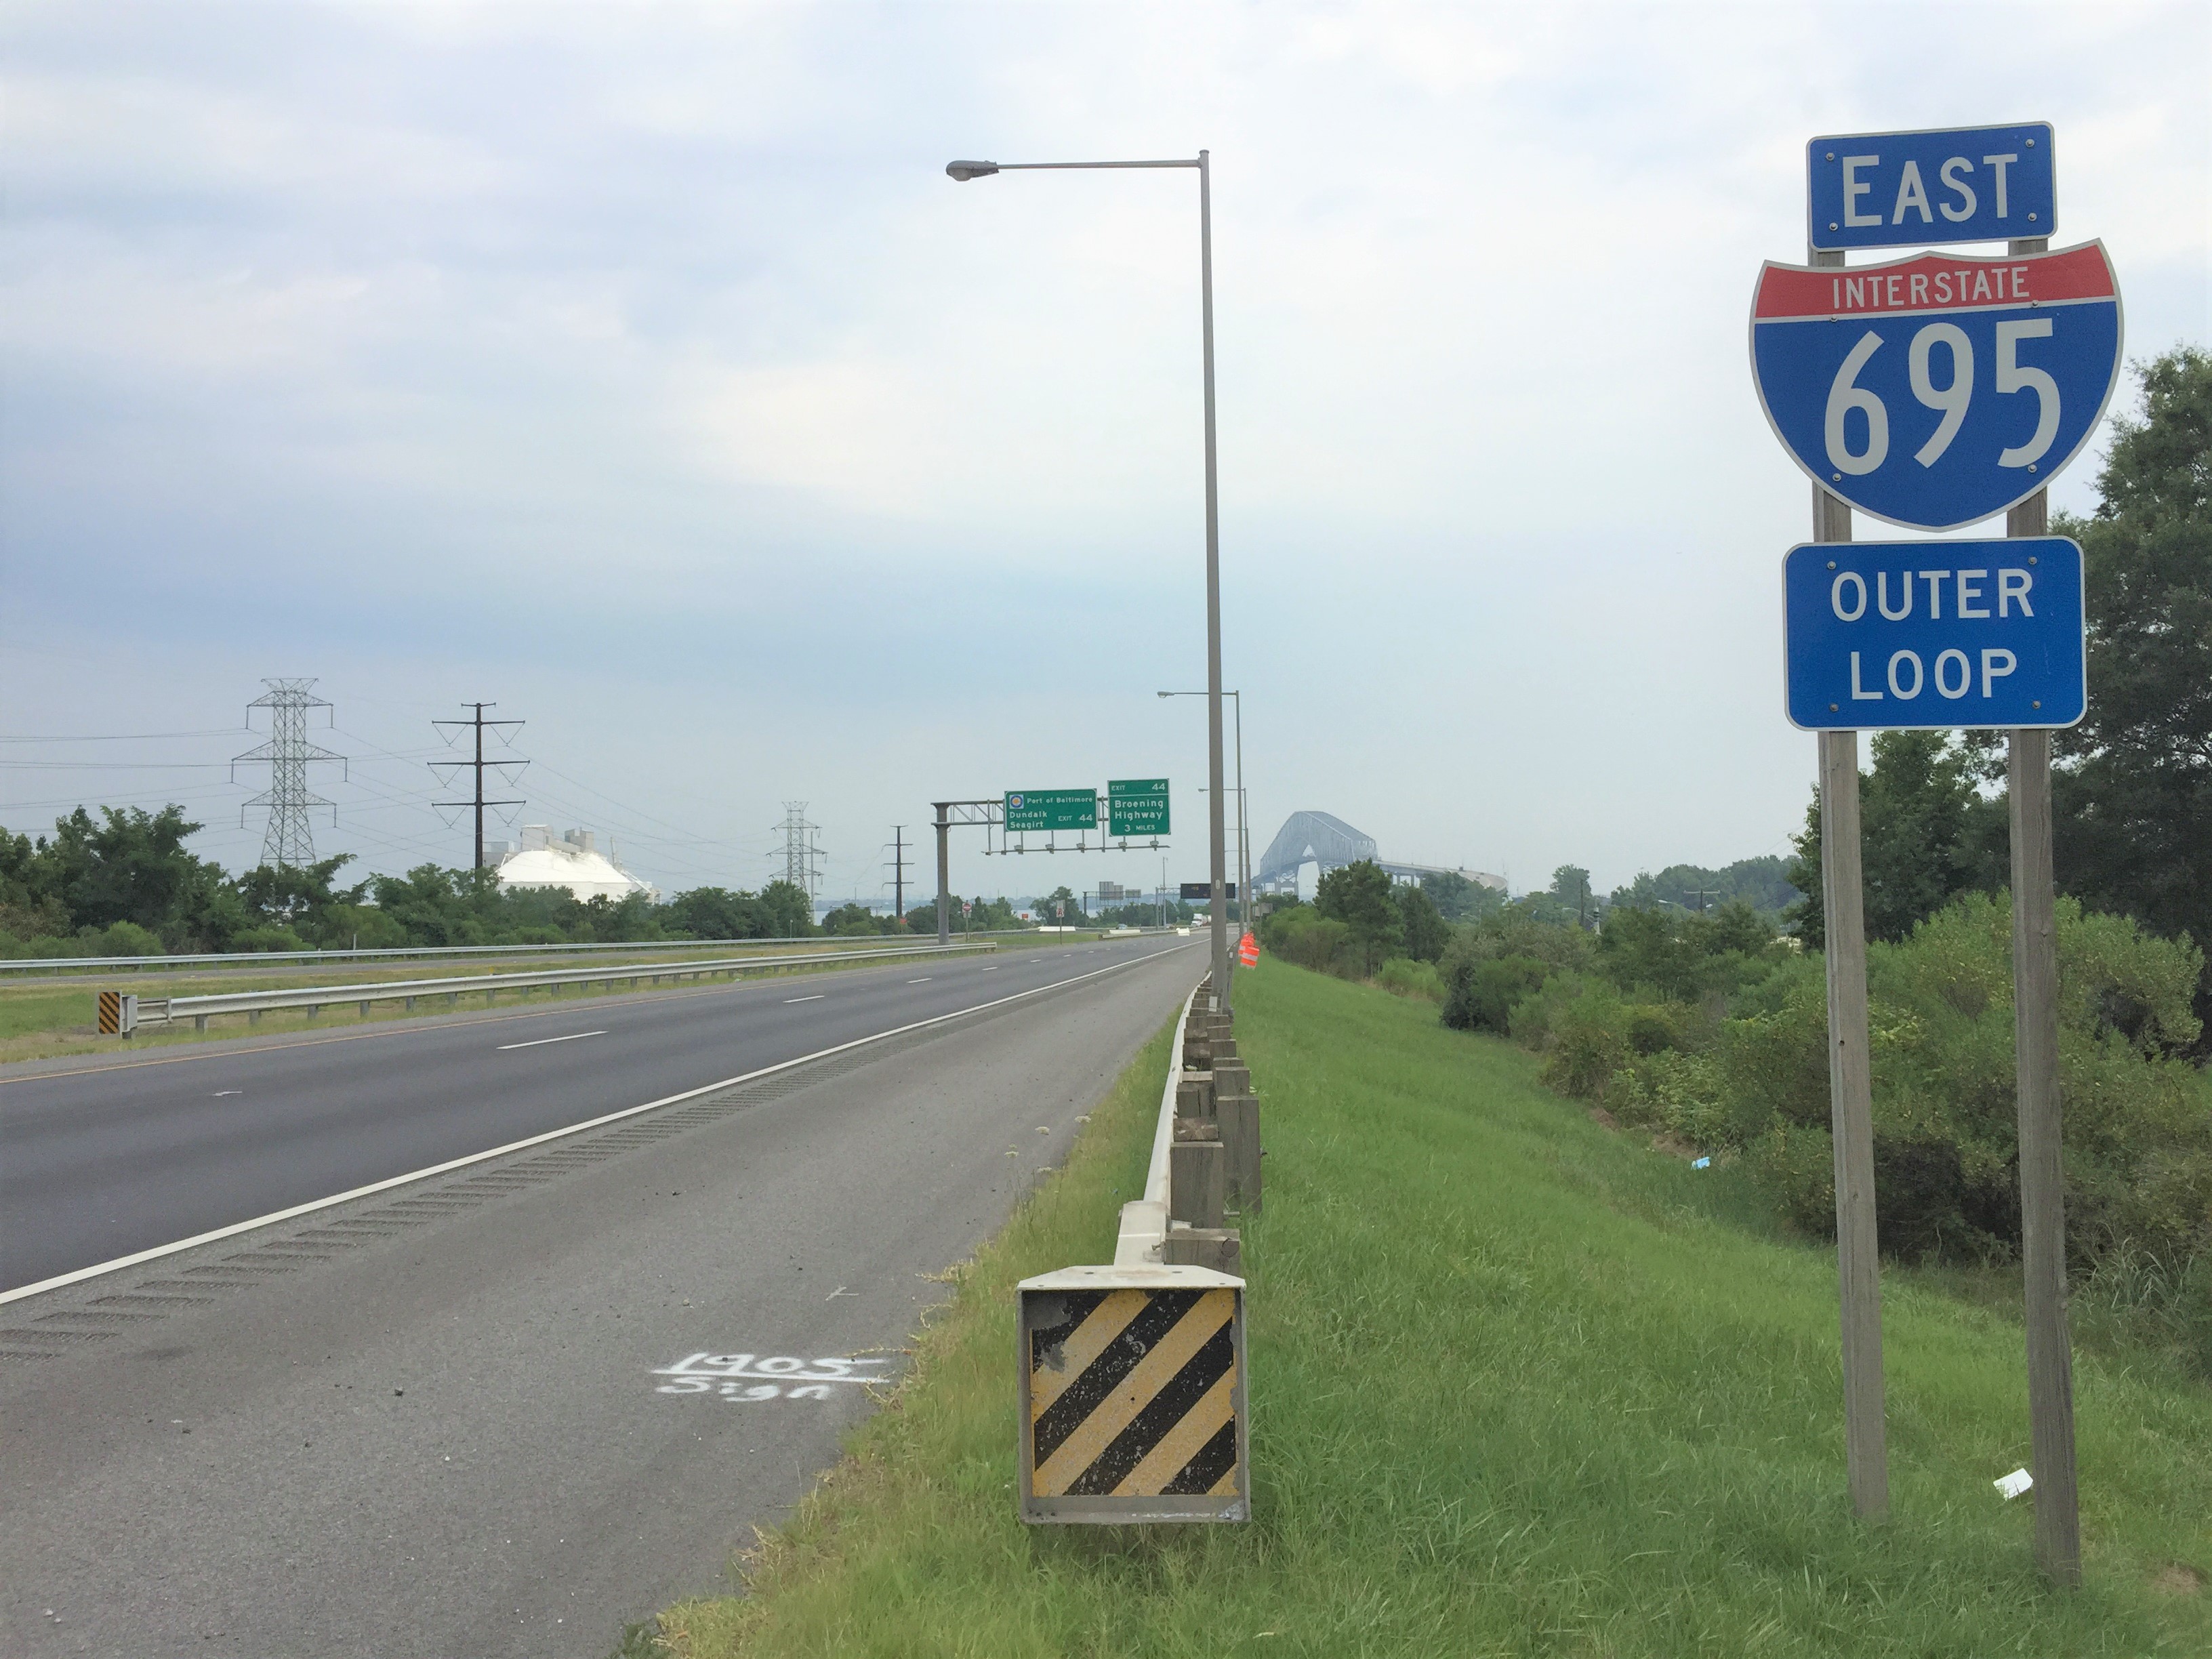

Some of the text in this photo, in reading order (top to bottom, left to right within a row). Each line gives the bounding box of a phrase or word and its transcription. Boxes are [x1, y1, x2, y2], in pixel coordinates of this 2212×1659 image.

[1842, 153, 2018, 228] EAST
[1832, 266, 2030, 309] INTERSTATE
[1824, 317, 2061, 476] 695
[1831, 568, 2034, 621] OUTER
[1850, 649, 2018, 700] LOOP
[1009, 811, 1048, 819] Dundalk
[1114, 800, 1164, 809] Broening
[1115, 811, 1163, 821] Highway
[1010, 821, 1044, 830] Seagirt
[1124, 824, 1131, 832] 3
